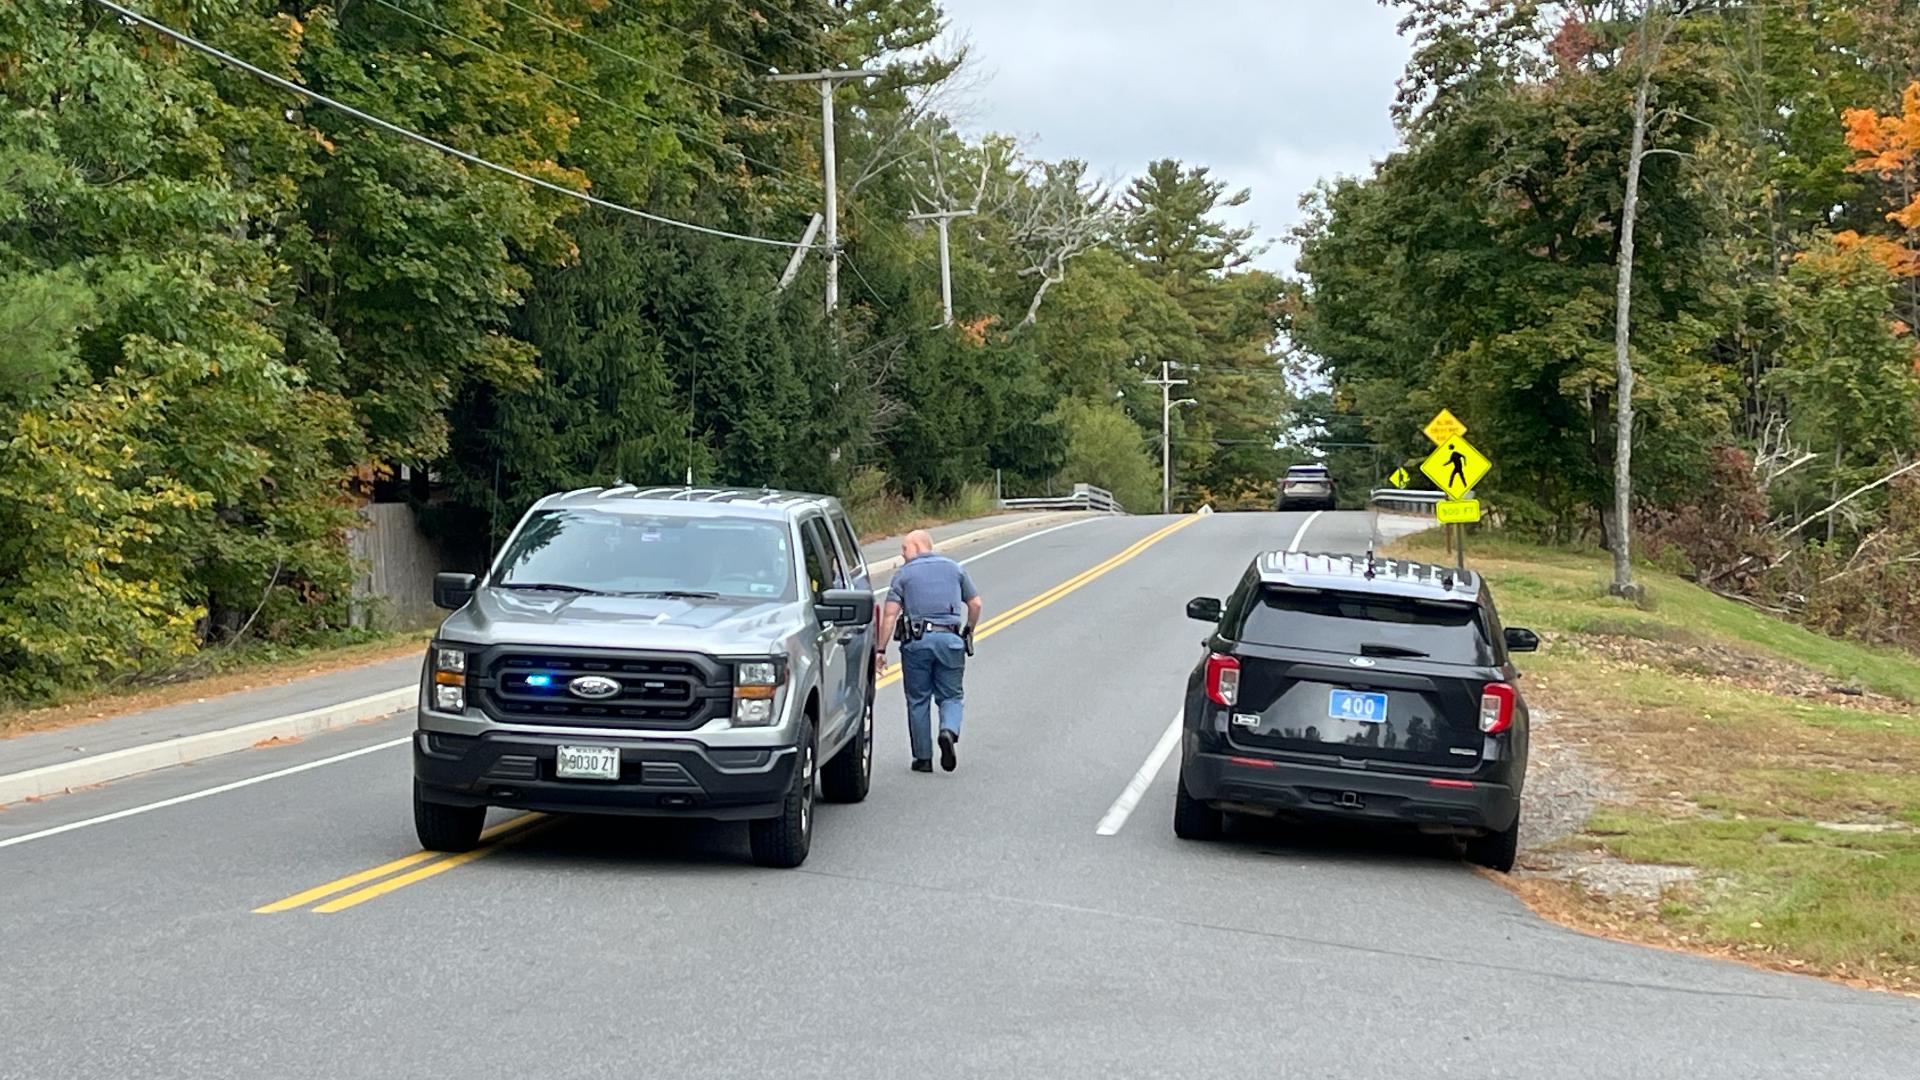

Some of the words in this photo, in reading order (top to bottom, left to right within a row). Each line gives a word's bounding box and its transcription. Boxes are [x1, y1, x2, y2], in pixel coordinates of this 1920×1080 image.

[1341, 697, 1375, 716] 400
[569, 754, 598, 771] 9030
[601, 755, 615, 772] ZT
